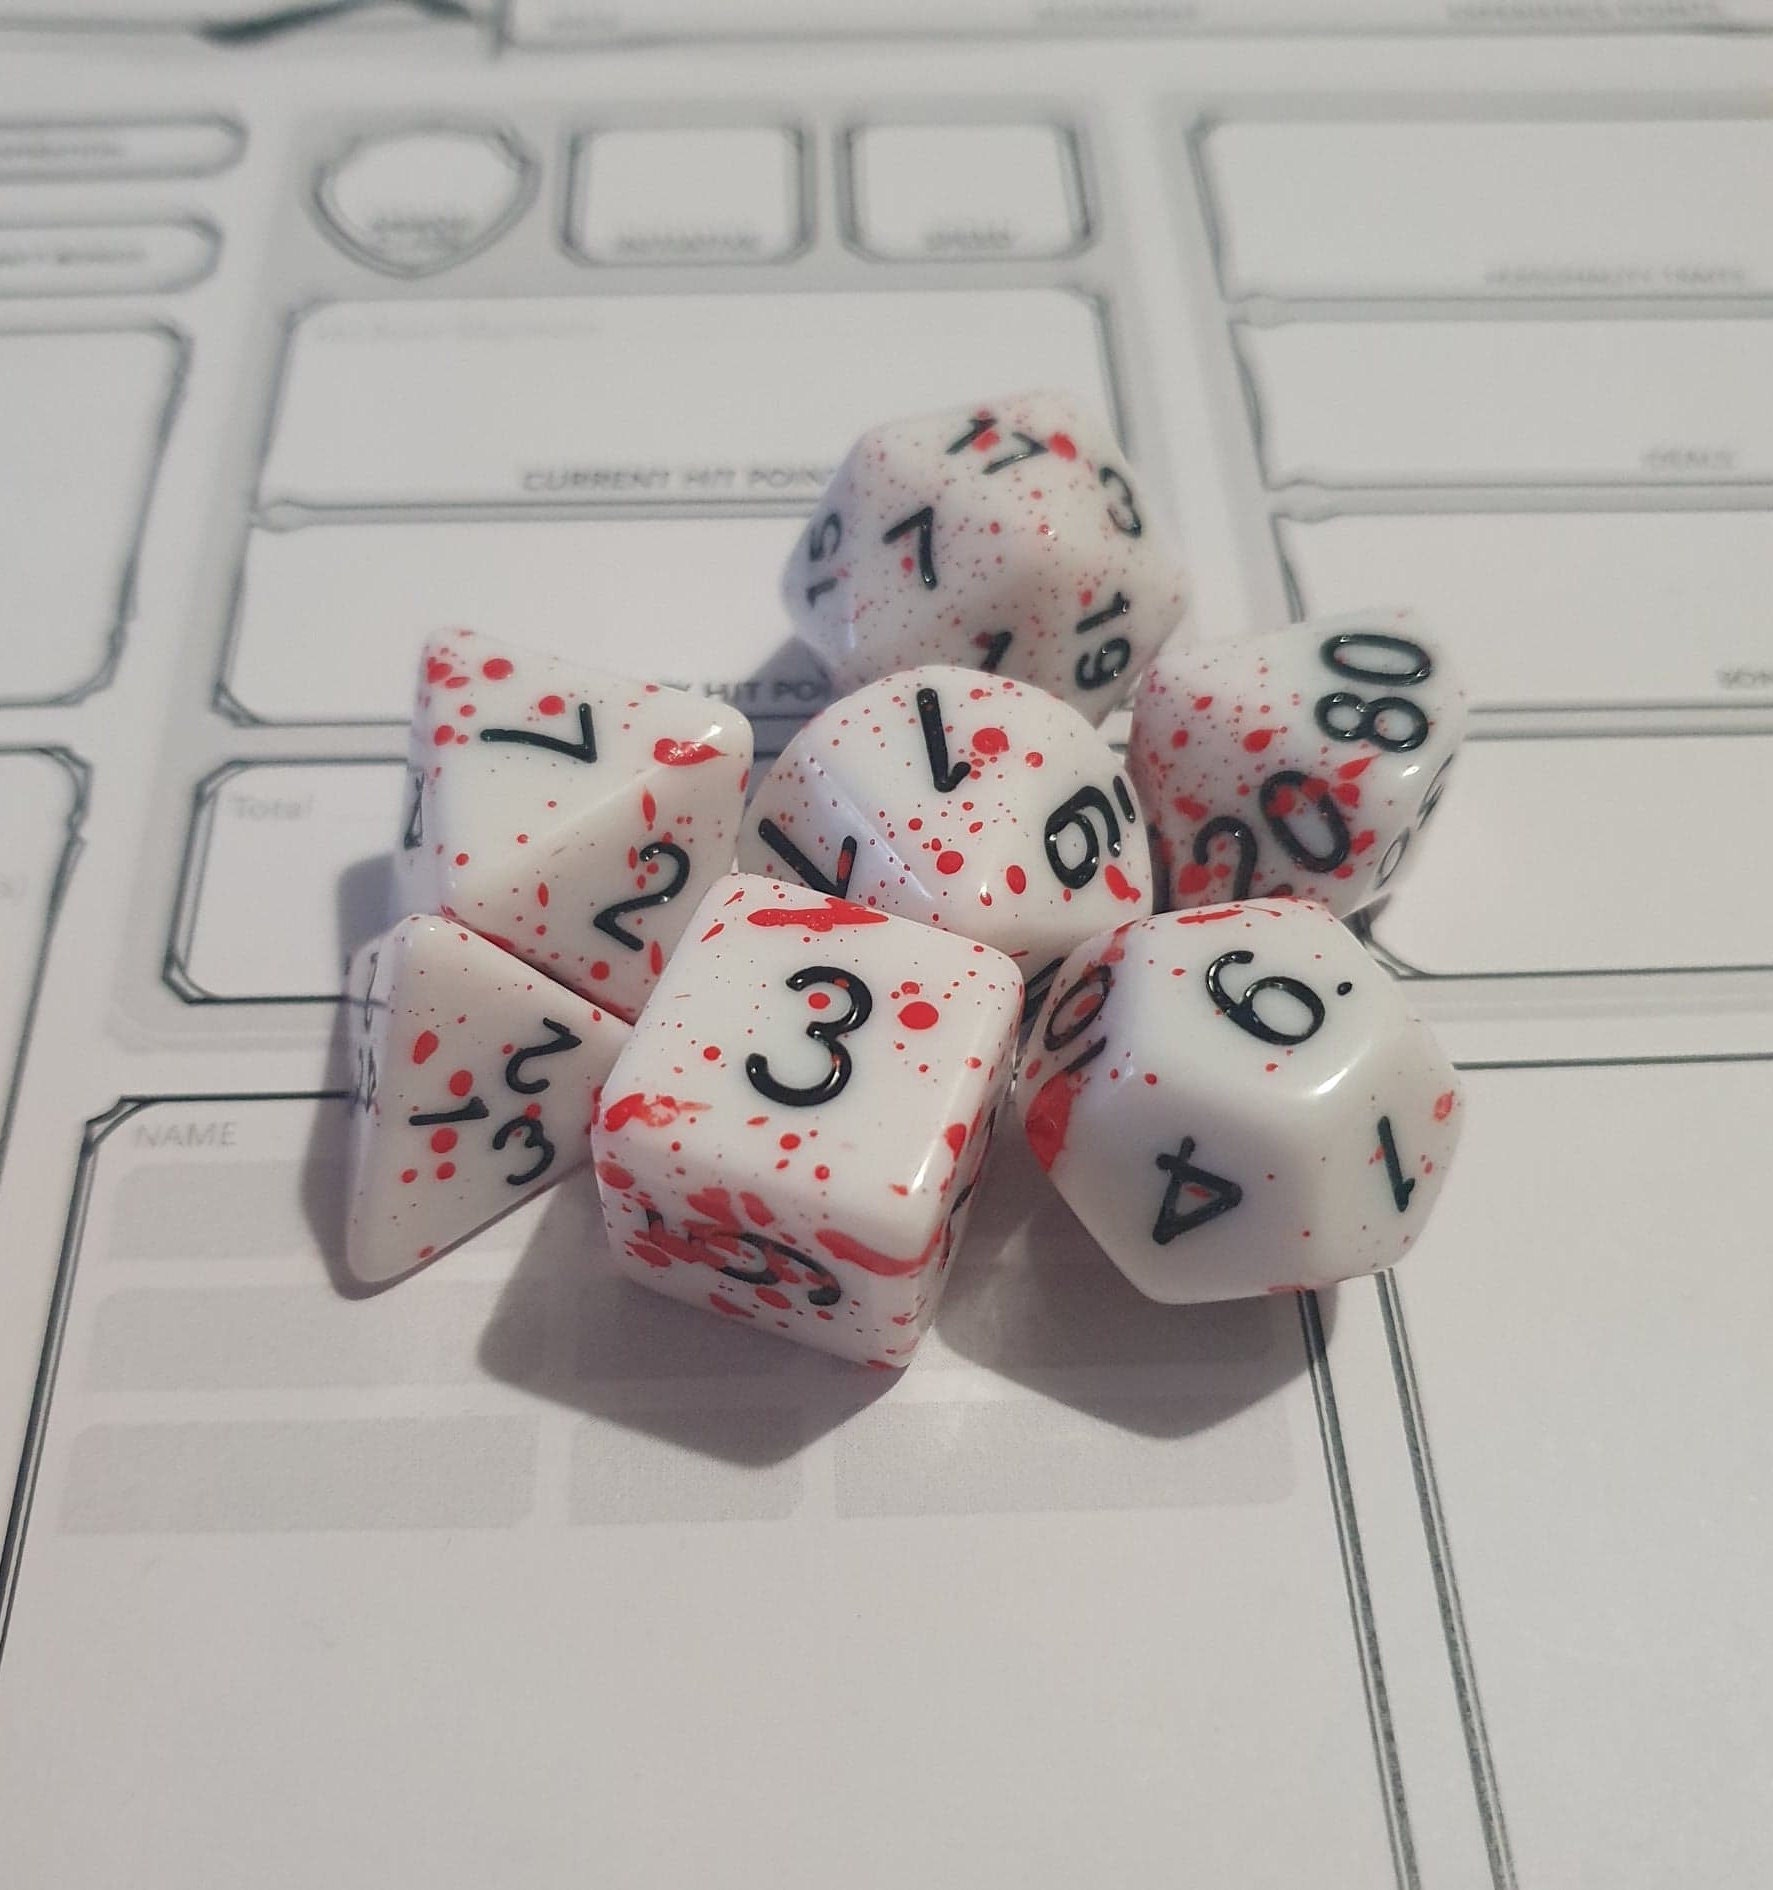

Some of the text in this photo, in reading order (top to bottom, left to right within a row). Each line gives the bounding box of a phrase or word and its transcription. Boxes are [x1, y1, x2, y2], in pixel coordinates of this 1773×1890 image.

[522, 468, 835, 492] CURRENT HIT POIN
[946, 416, 1048, 476] 17
[1099, 465, 1141, 538] 3
[883, 505, 938, 591] 7
[1314, 632, 1433, 753] 80
[480, 702, 598, 764] 7
[916, 687, 972, 793] 1
[230, 794, 313, 821] Total
[592, 841, 691, 952] 2
[505, 1016, 583, 1095] 2
[745, 965, 874, 1107] 3
[132, 1121, 239, 1148] NAME
[408, 1096, 490, 1126] 1
[492, 1114, 555, 1187] 3
[1376, 1113, 1417, 1214] 1
[1151, 1134, 1245, 1246] 4
